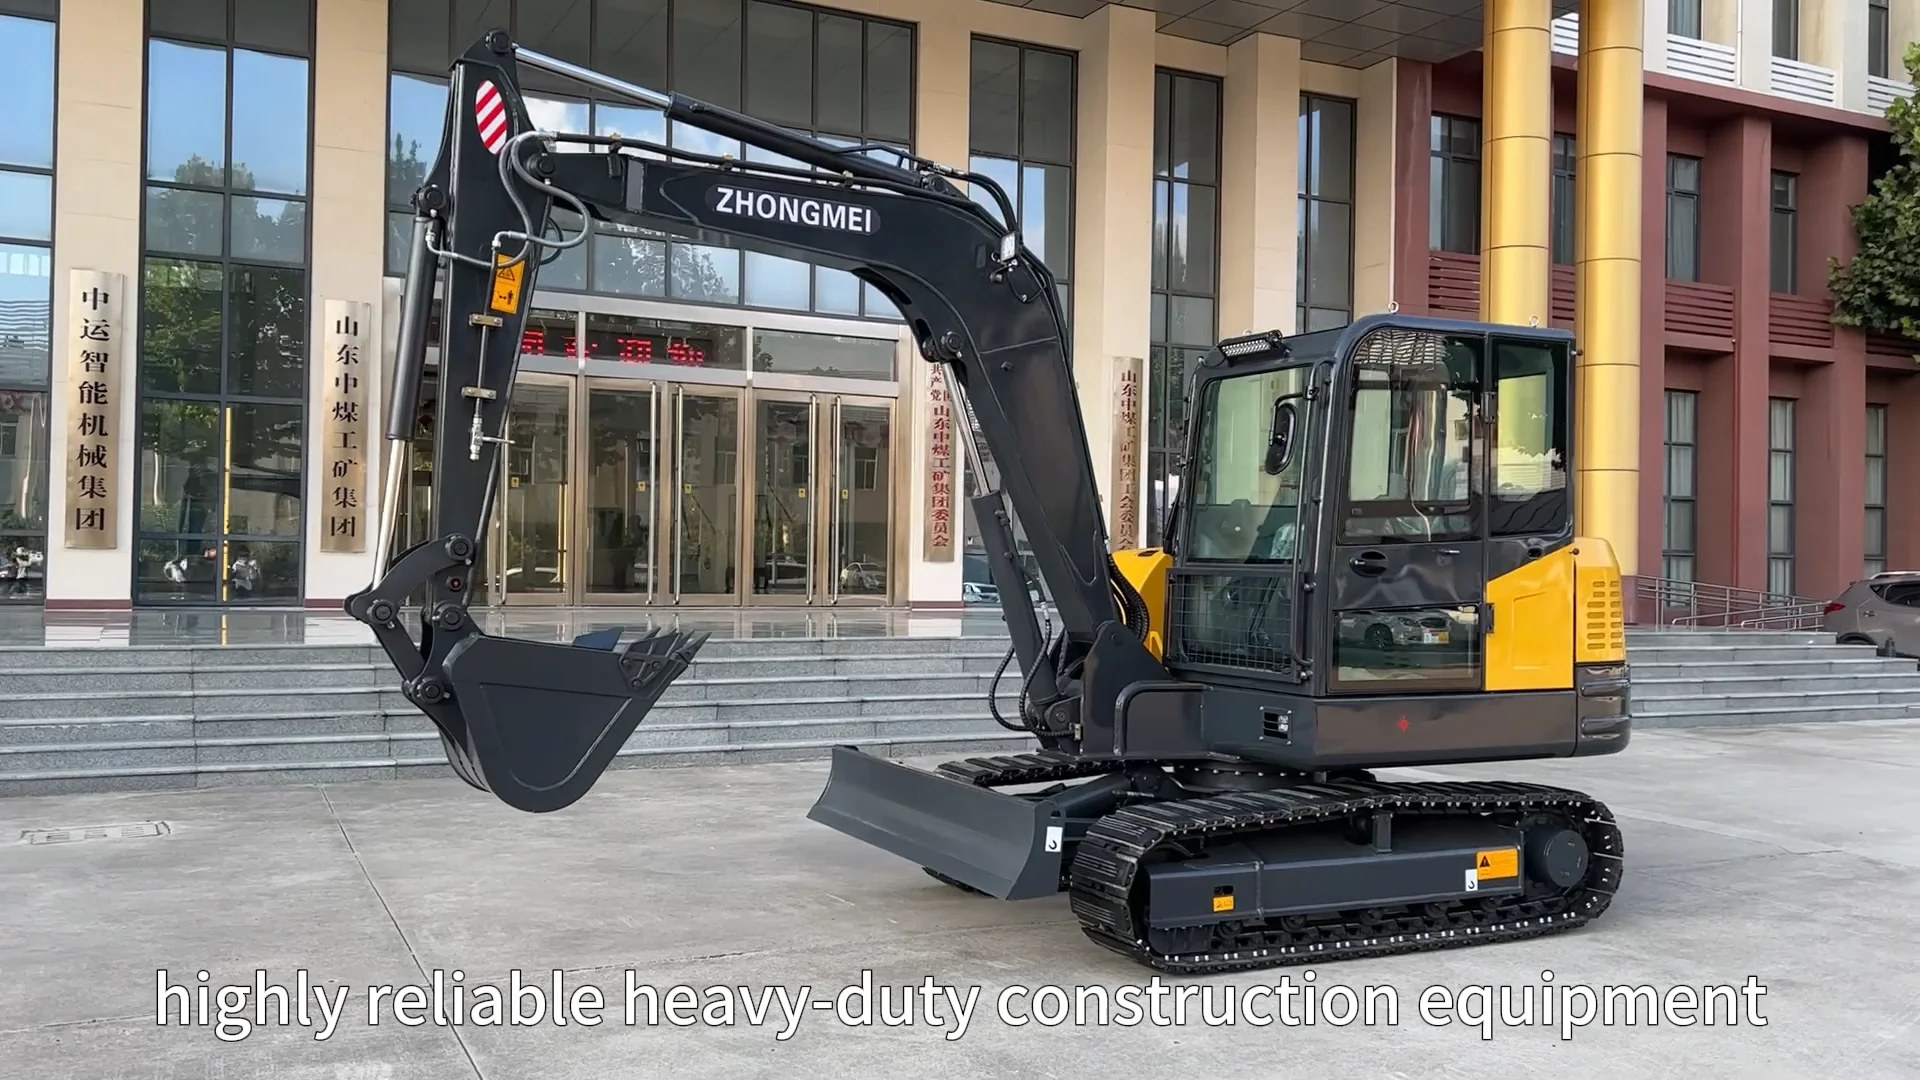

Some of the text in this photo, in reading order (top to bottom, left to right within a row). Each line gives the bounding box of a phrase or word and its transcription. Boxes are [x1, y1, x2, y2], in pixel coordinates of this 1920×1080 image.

[715, 186, 872, 233] ZHONGMEI
[75, 286, 111, 531] 中运智能机械集团
[330, 315, 360, 538] 山东中煤工矿集团
